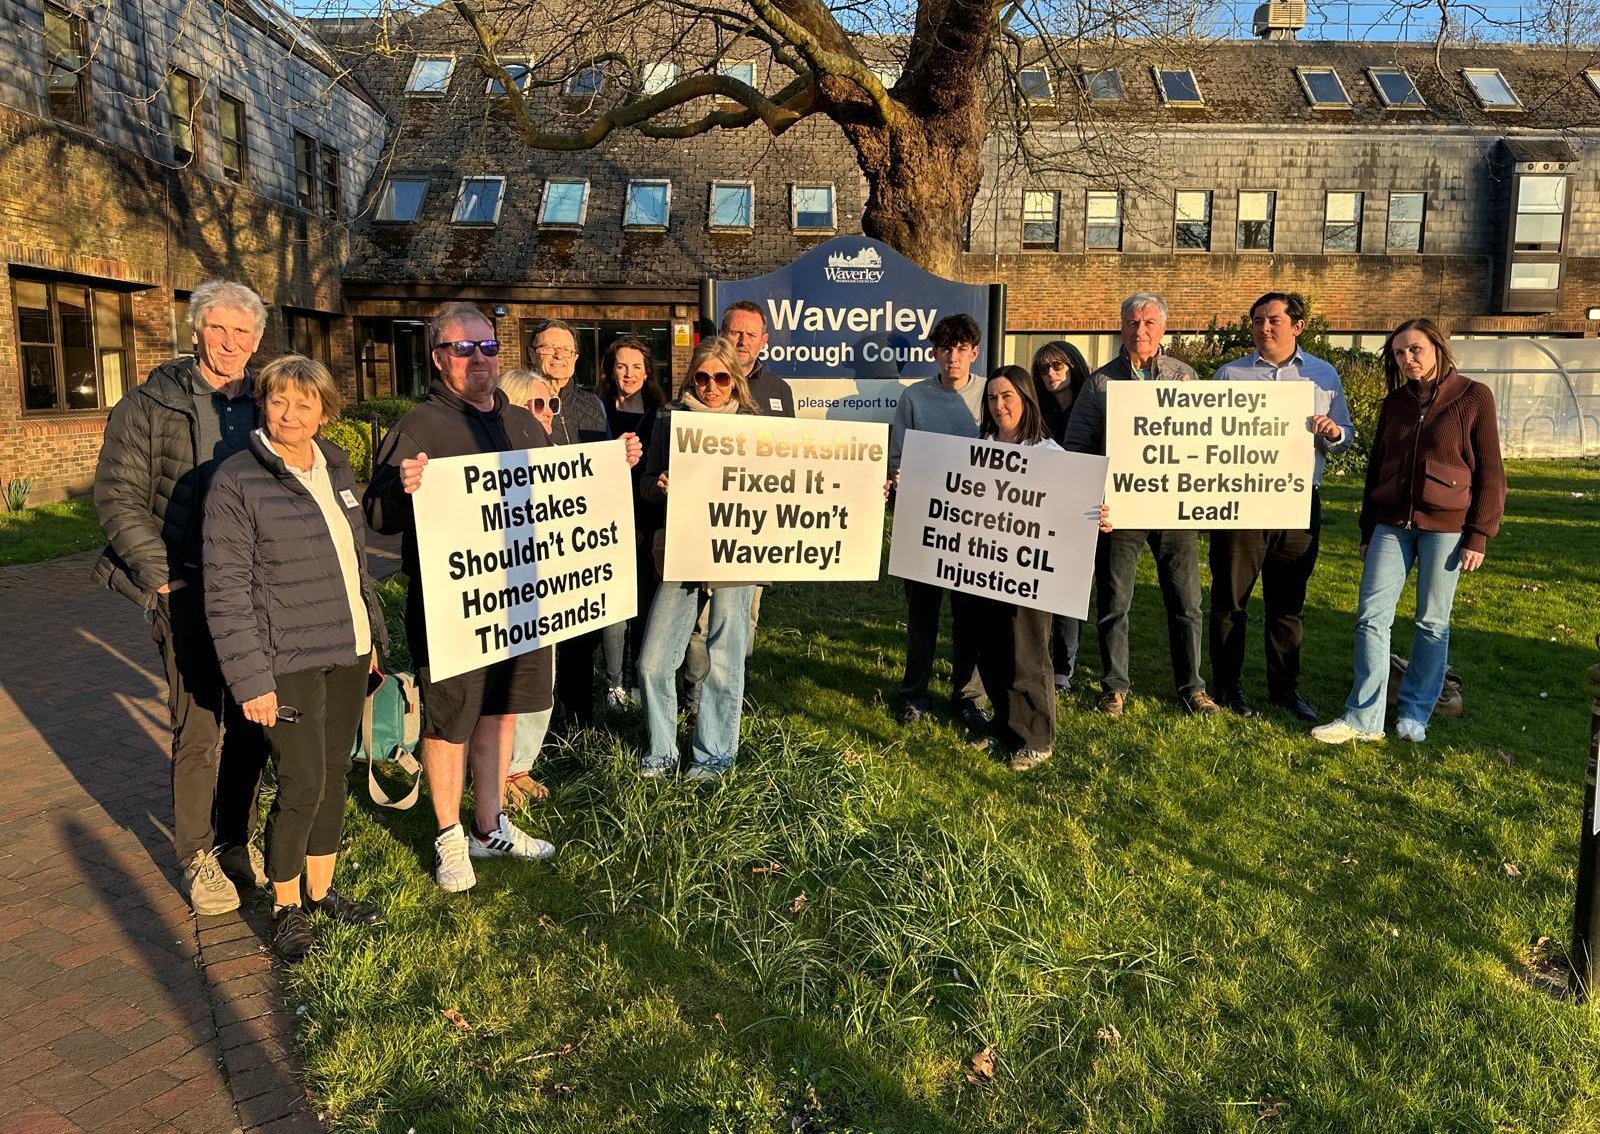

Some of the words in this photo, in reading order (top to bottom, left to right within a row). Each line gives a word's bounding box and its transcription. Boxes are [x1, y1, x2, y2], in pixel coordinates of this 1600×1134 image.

[824, 267, 885, 283] Waverley
[767, 299, 937, 340] Waverley
[863, 342, 936, 362] Counc
[798, 398, 839, 410] please
[843, 398, 883, 410] report
[885, 398, 897, 408] to
[1156, 388, 1266, 412] Waverley:
[1134, 416, 1212, 436] Refund
[1222, 416, 1289, 436] Unfair
[676, 427, 746, 456] West
[756, 432, 883, 461] Berkshire
[970, 445, 1028, 474] WBC:
[1143, 445, 1180, 464] CIL
[1206, 445, 1279, 464] Follow
[464, 453, 593, 496] Paperwork
[722, 466, 796, 493] Fixed
[806, 470, 824, 494] It
[946, 472, 986, 497] Use
[995, 479, 1046, 508] Your
[1113, 473, 1169, 492] West
[1177, 473, 1304, 492] Berkshire’s
[481, 494, 587, 532] Mistakes
[709, 502, 767, 535] Why
[776, 504, 848, 529] Won’t
[928, 498, 1040, 539] Discretion
[1178, 501, 1239, 521] Lead!
[449, 532, 564, 580] Shouldn’t
[572, 521, 618, 552] Cost
[712, 539, 841, 570] Waverley!
[922, 526, 961, 553] End
[968, 536, 1008, 563] this
[1017, 546, 1055, 572] CIL
[462, 562, 613, 618] Homeowners
[937, 559, 1039, 599] Injustice!
[475, 593, 606, 654] Thousands!
